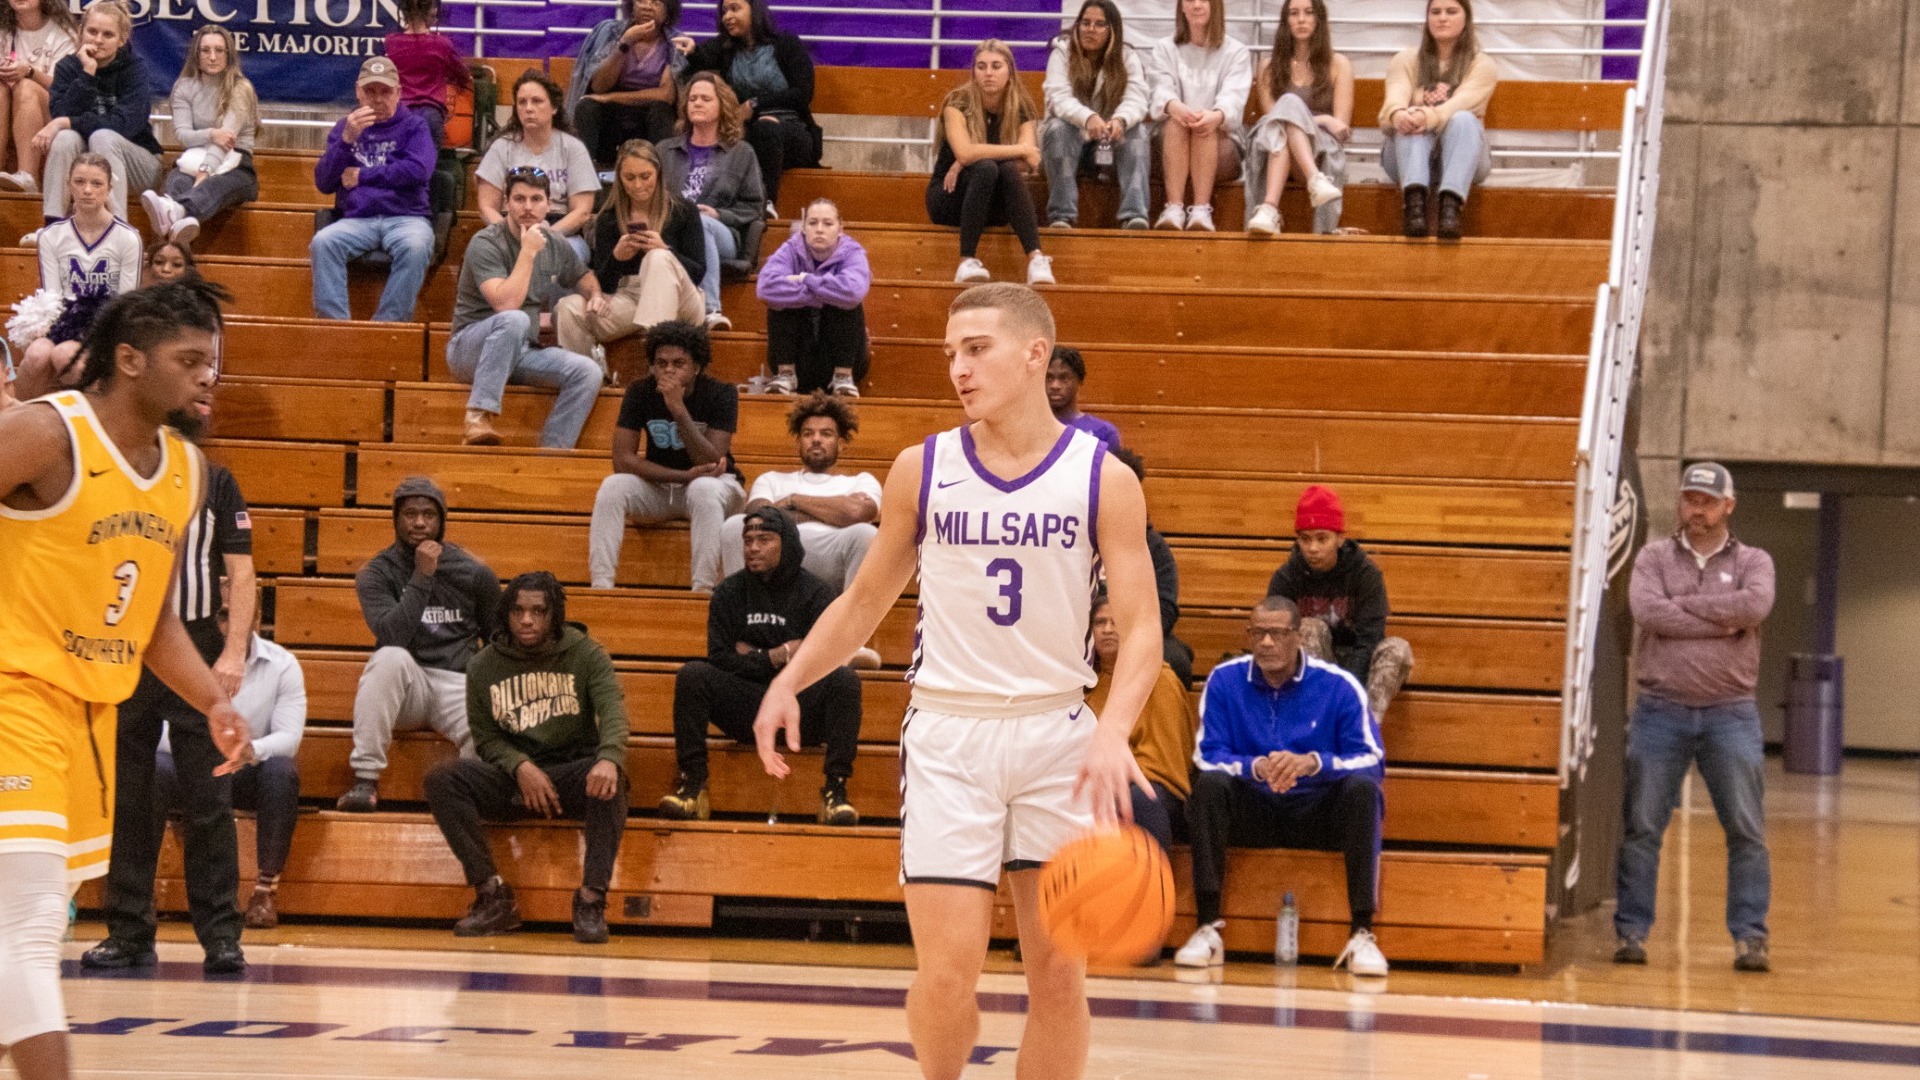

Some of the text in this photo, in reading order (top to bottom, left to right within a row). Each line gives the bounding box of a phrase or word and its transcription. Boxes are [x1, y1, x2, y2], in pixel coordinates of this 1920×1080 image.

[257, 33, 388, 56] MAJORIT
[934, 511, 1079, 549] MILLSAPS
[103, 559, 141, 627] 3
[986, 557, 1023, 627] 3
